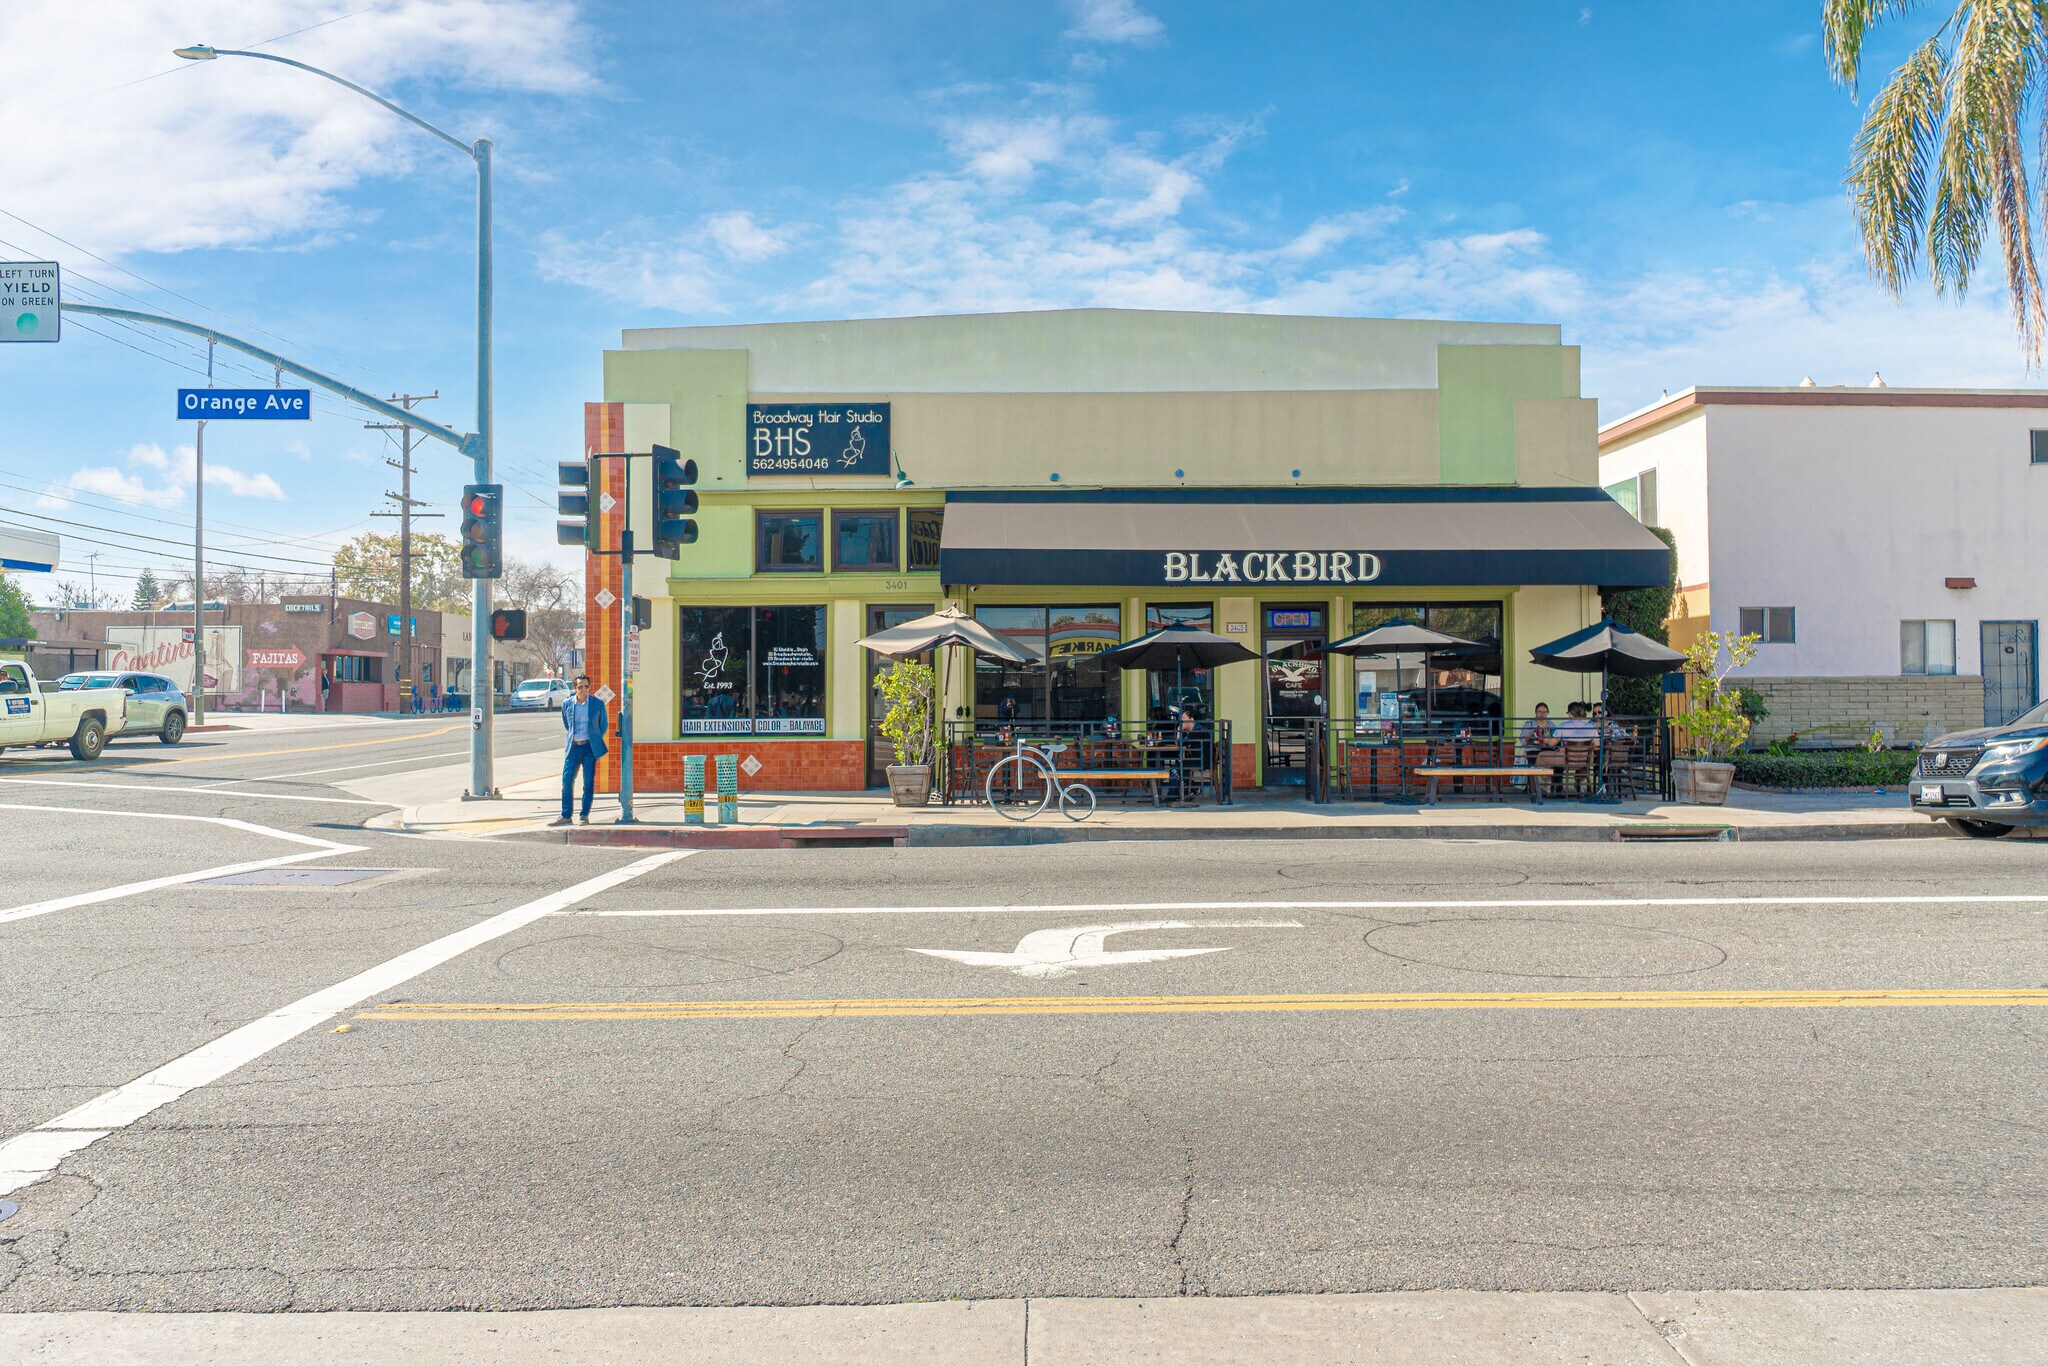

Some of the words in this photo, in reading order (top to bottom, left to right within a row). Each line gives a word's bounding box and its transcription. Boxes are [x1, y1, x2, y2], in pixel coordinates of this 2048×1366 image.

[0, 270, 22, 278] LEFT
[29, 270, 54, 278] TURN
[4, 283, 51, 293] YIELD
[2, 298, 14, 306] ON
[22, 298, 54, 306] GREEN
[185, 394, 257, 414] Orange
[264, 394, 303, 410] Ave
[753, 410, 813, 427] Broadway
[818, 410, 841, 423] Hair
[846, 410, 883, 423] Studio
[753, 428, 811, 456] BHS
[753, 459, 829, 469] 5624954046
[1164, 552, 1381, 583] BLACKBIRD
[885, 581, 907, 590] 3401
[1273, 612, 1310, 626] OPEN
[252, 653, 298, 664] FAJITAS
[716, 681, 733, 690] 1993
[683, 720, 702, 731] HAIR
[704, 720, 751, 732] EXTENSIONS
[757, 720, 781, 731] COLOR
[789, 720, 823, 731] BALAYAGE
